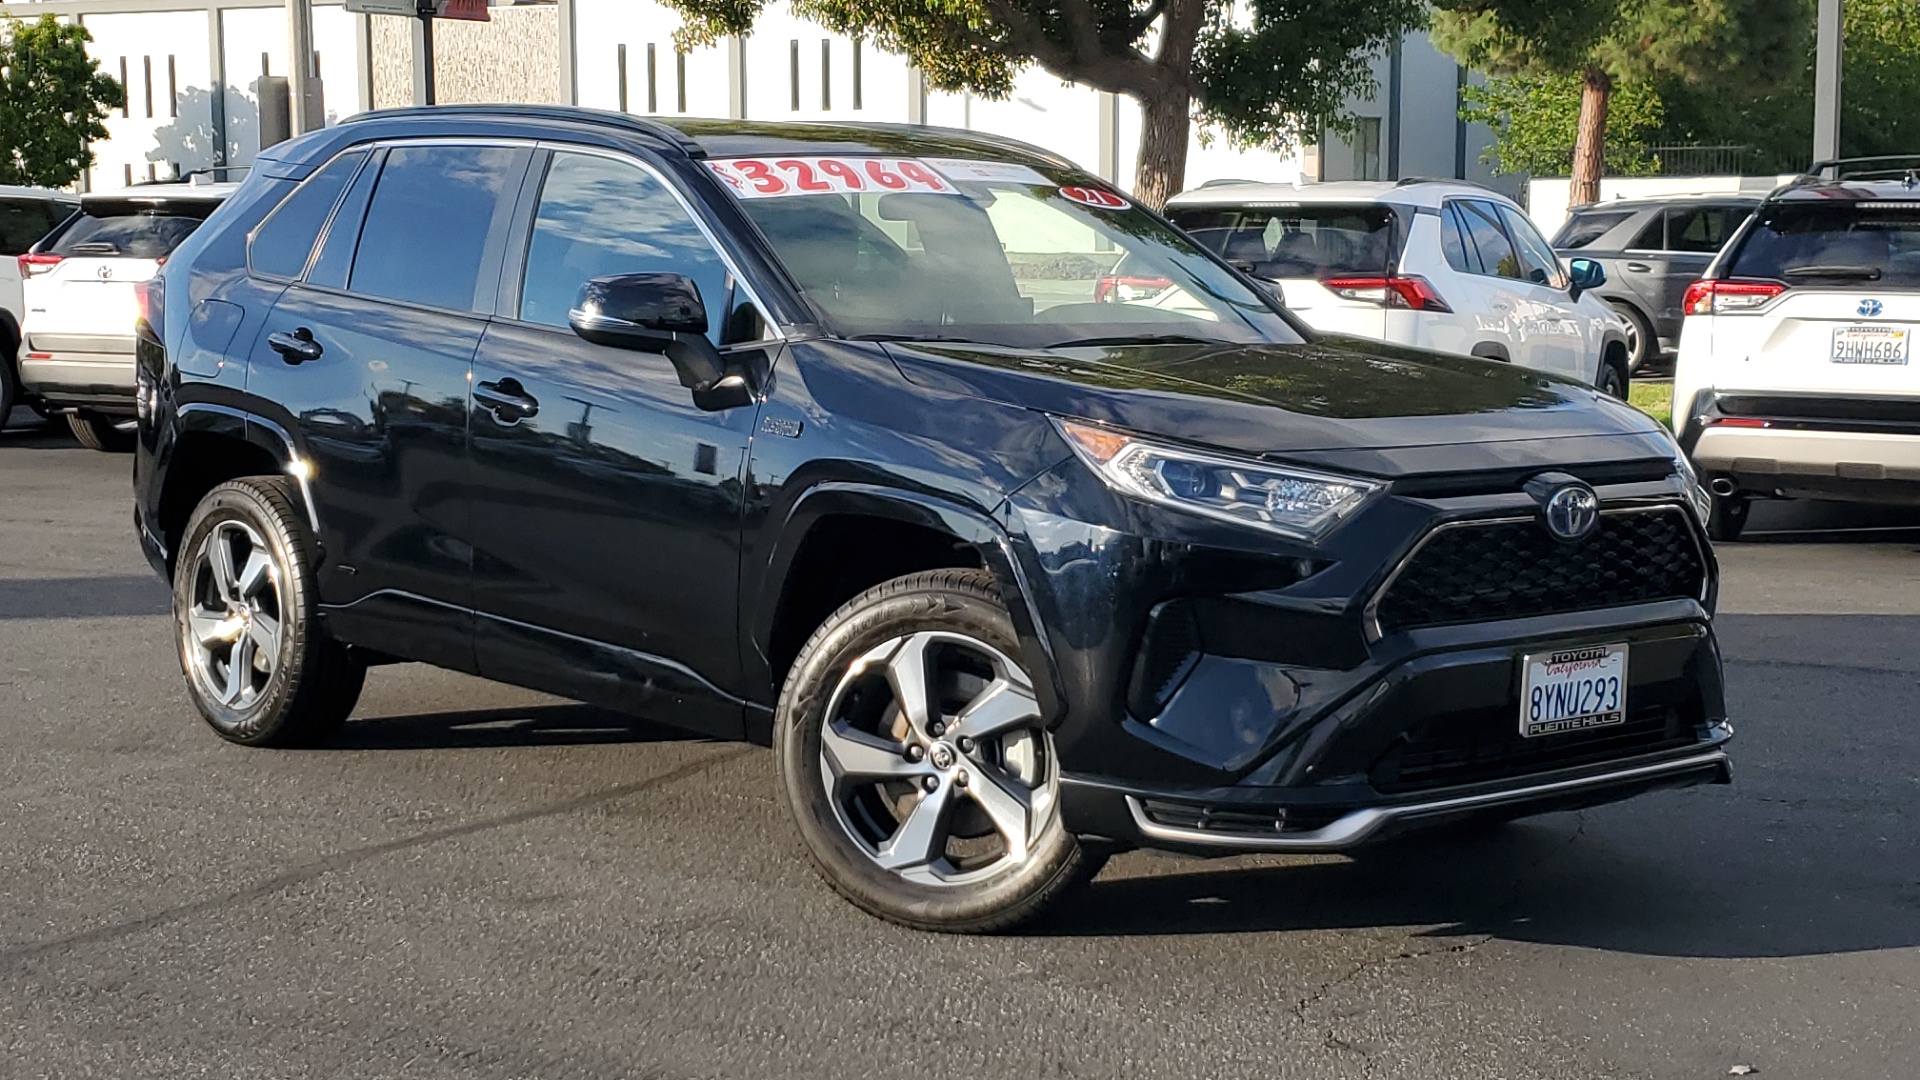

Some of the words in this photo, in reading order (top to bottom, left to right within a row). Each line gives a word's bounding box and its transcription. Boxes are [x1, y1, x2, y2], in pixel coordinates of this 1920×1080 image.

[1074, 187, 1110, 205] 21
[1836, 341, 1903, 359] 9HWH686
[1553, 648, 1604, 661] TOYOTA
[1546, 659, 1608, 678] California
[1530, 676, 1619, 721] 8YNU293
[1530, 720, 1581, 734] PUENTE
[1582, 712, 1620, 727] HILLS
